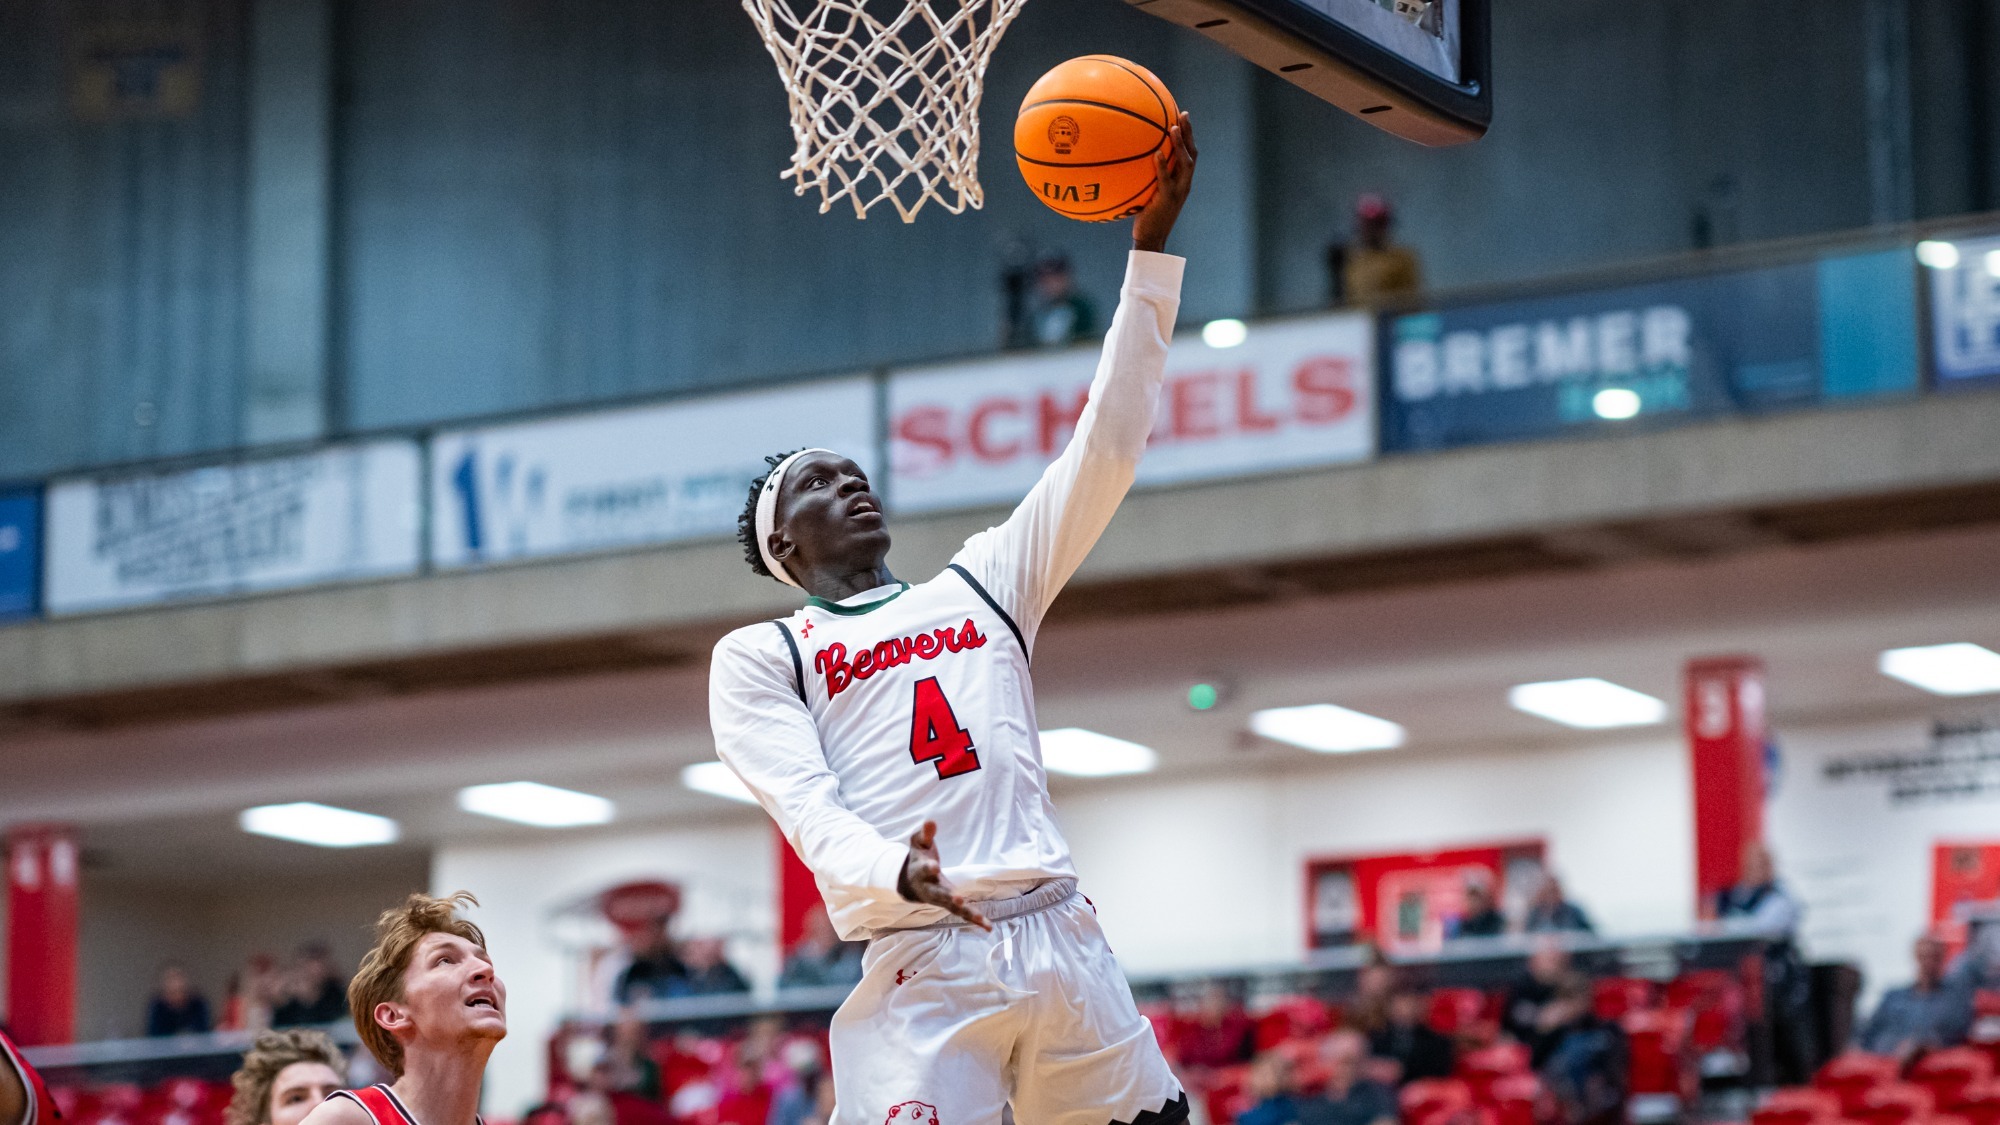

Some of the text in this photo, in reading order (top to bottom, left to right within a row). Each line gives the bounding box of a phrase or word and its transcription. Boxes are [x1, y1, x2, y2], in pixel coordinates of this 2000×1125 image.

[1043, 182, 1101, 203] EVO
[1393, 306, 1690, 399] BREMER
[890, 355, 1358, 465] SCHELS
[815, 618, 988, 701] Beavers
[909, 675, 982, 781] 4
